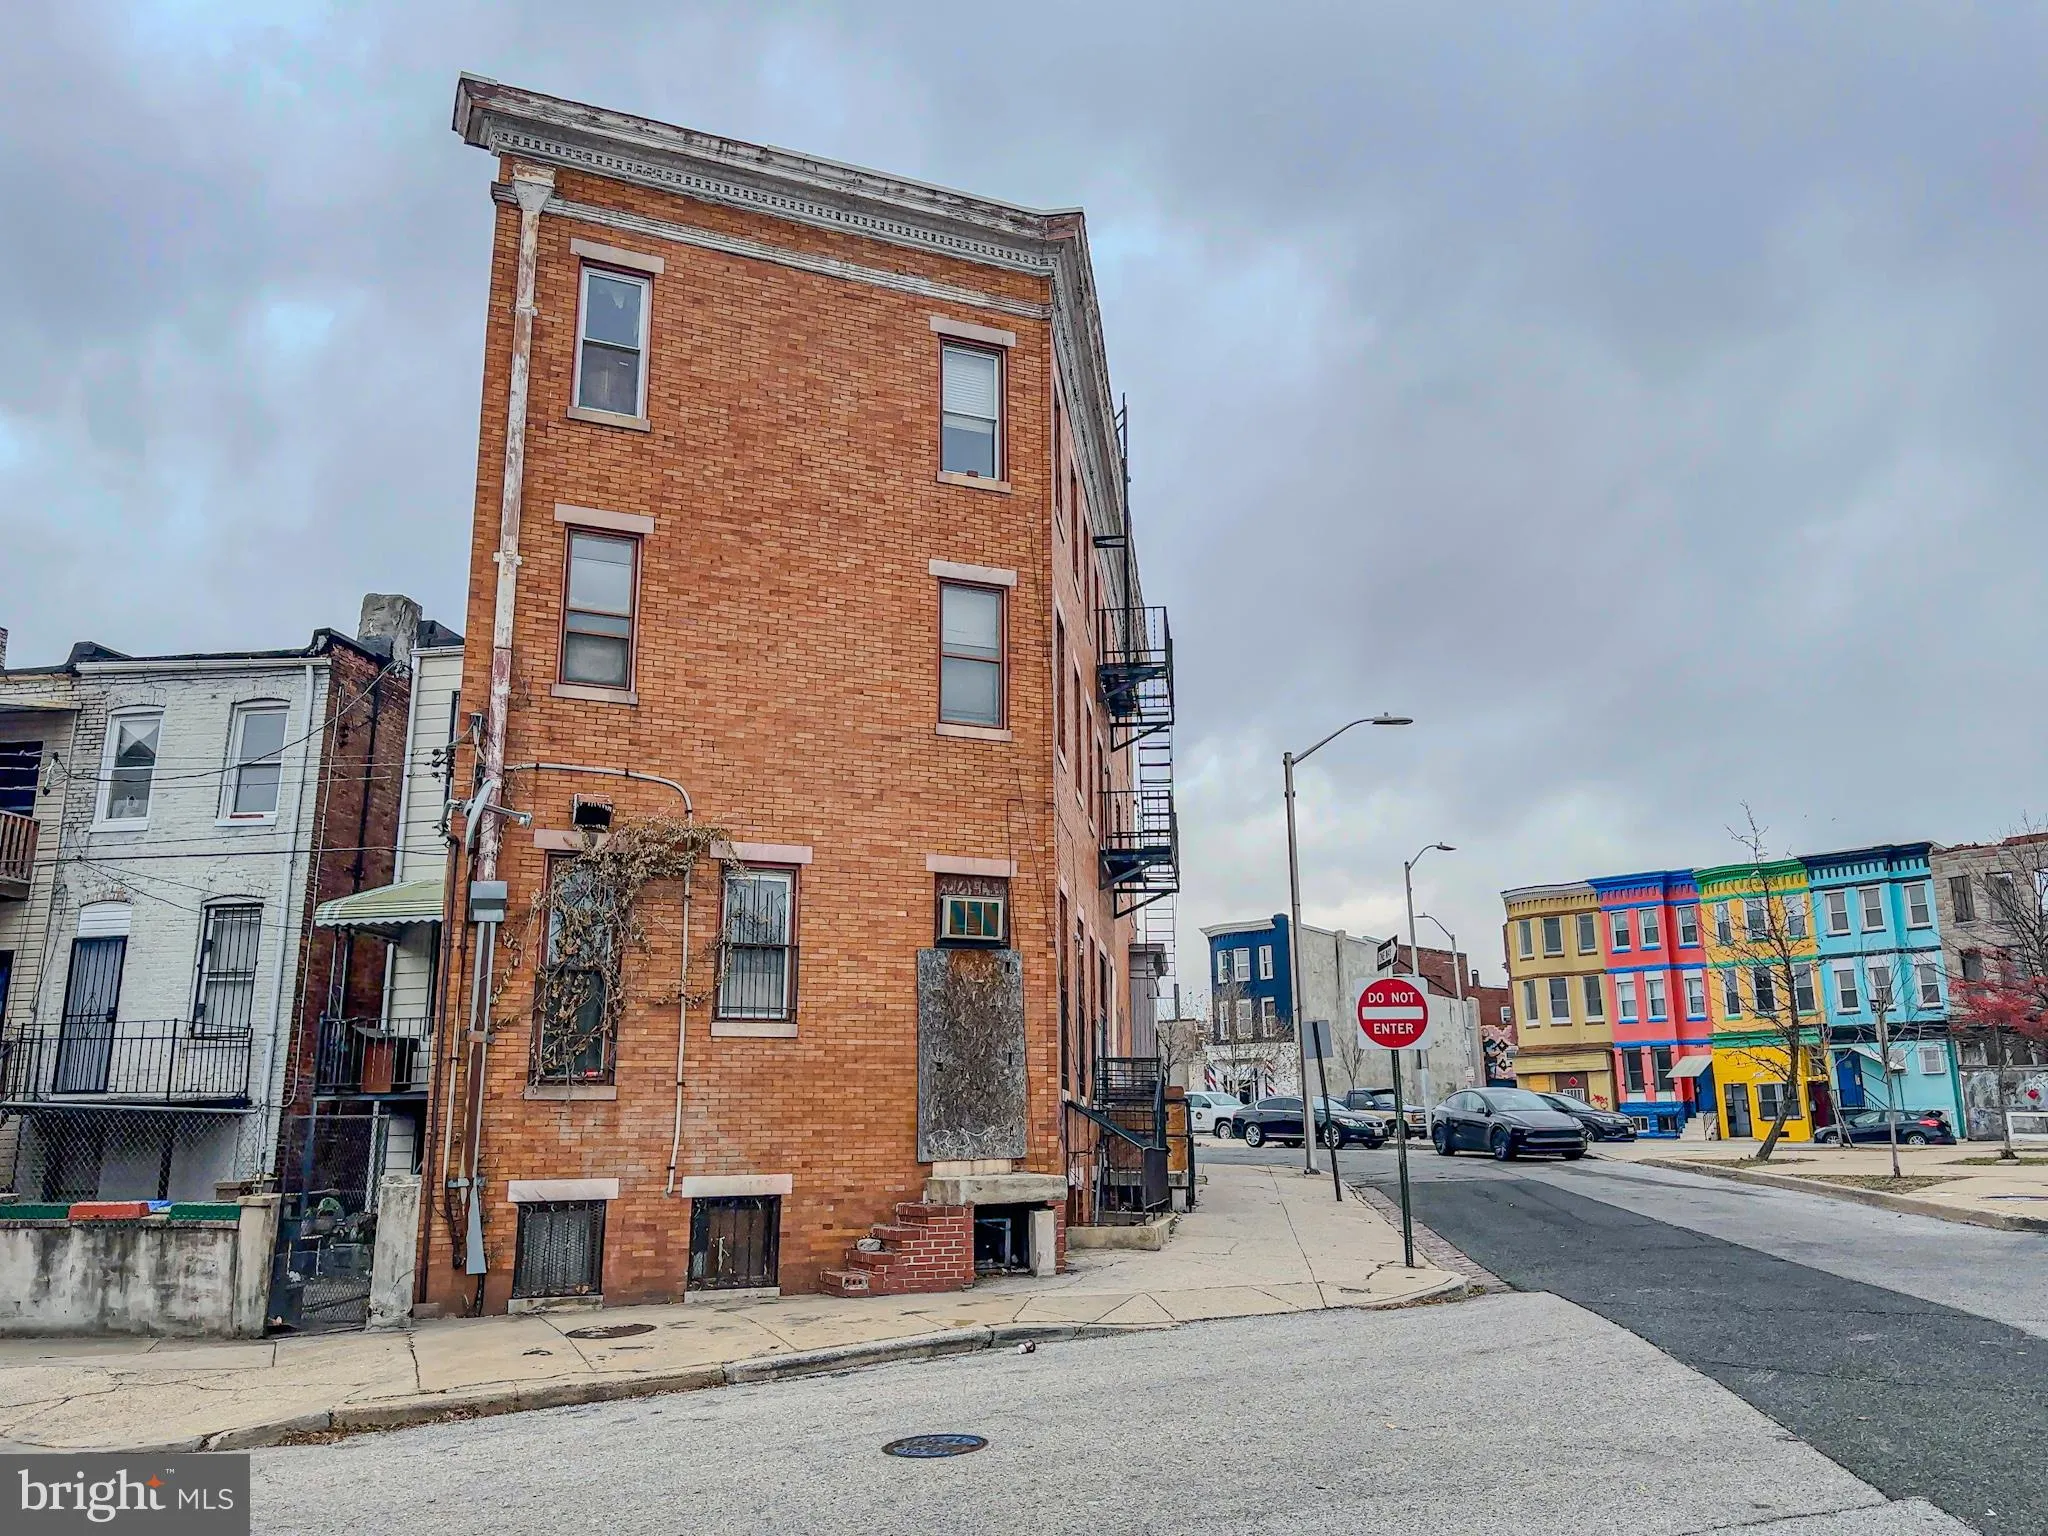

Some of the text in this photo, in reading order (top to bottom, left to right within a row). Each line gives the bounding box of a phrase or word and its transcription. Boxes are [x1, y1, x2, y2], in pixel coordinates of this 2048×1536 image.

[1368, 992, 1415, 1003] DO NOT
[1373, 1023, 1414, 1034] ENTER
